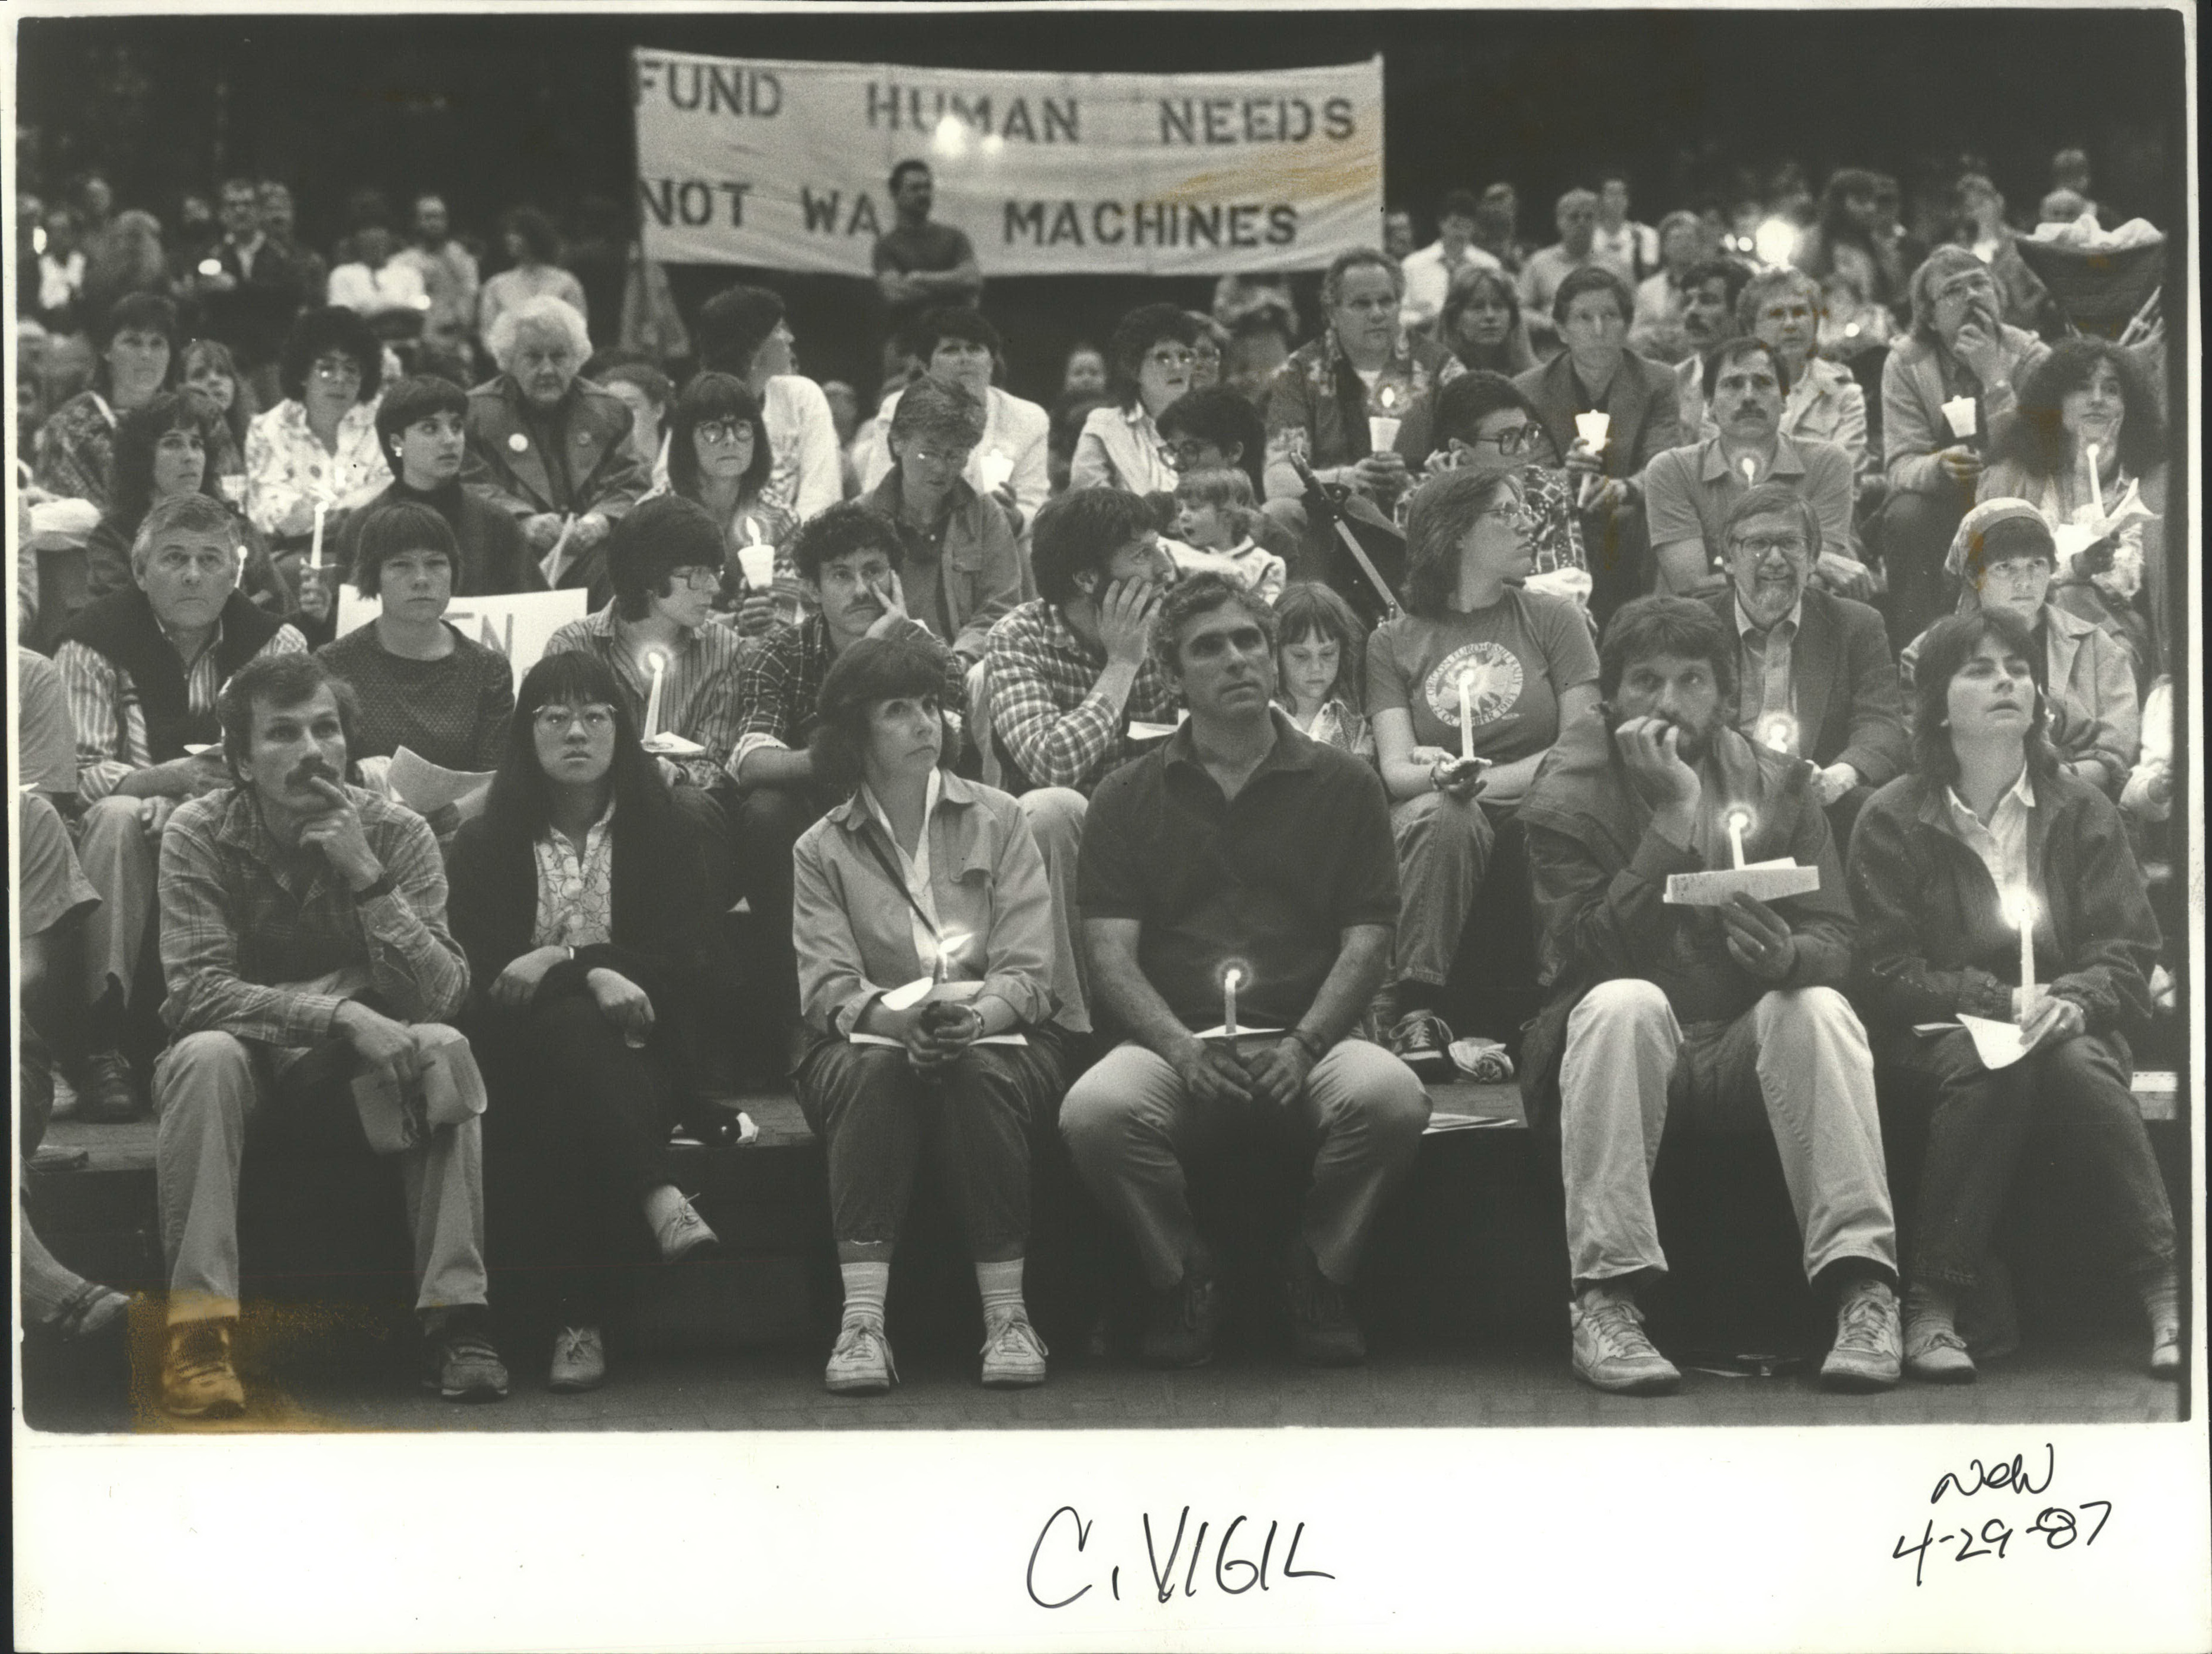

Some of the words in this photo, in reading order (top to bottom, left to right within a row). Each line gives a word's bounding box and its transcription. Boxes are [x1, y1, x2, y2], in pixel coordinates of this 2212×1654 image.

[867, 81, 1078, 144] HUMAN
[1160, 98, 1355, 144] NEEDS
[640, 179, 752, 228] NOT
[801, 186, 881, 235] WA
[1005, 199, 1298, 247] MACHINES
[1143, 1506, 1335, 1603] VIGIL
[1892, 1500, 2112, 1587] 4-29-87
